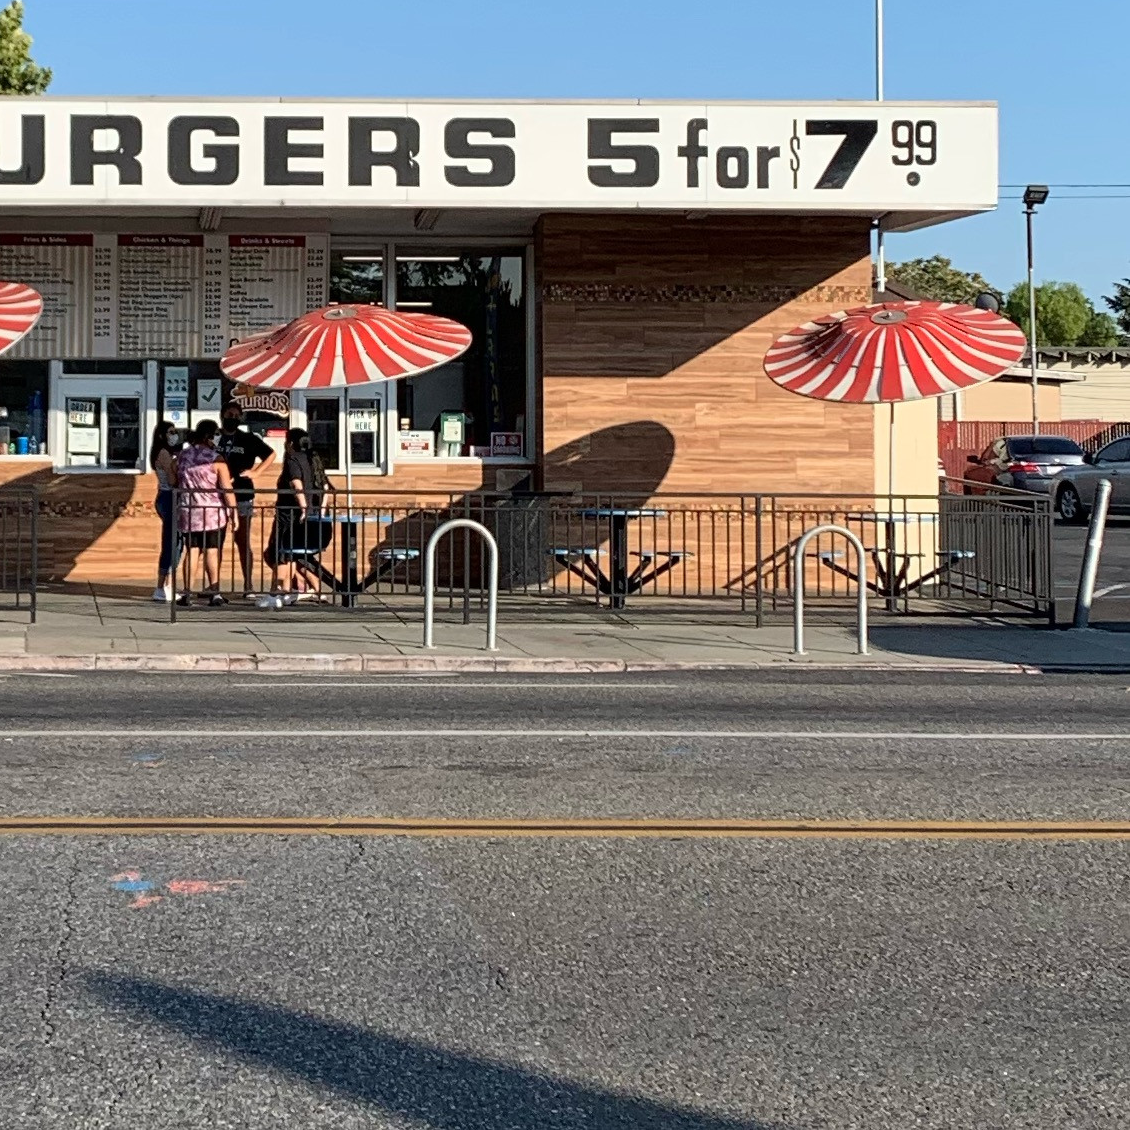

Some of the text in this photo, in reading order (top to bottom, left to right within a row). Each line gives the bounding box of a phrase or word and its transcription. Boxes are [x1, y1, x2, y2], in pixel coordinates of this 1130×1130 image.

[587, 117, 660, 188] 5
[677, 117, 781, 190] for
[132, 236, 191, 244] Chicken & Things
[348, 410, 364, 419] PICK
[354, 421, 372, 431] HERE
